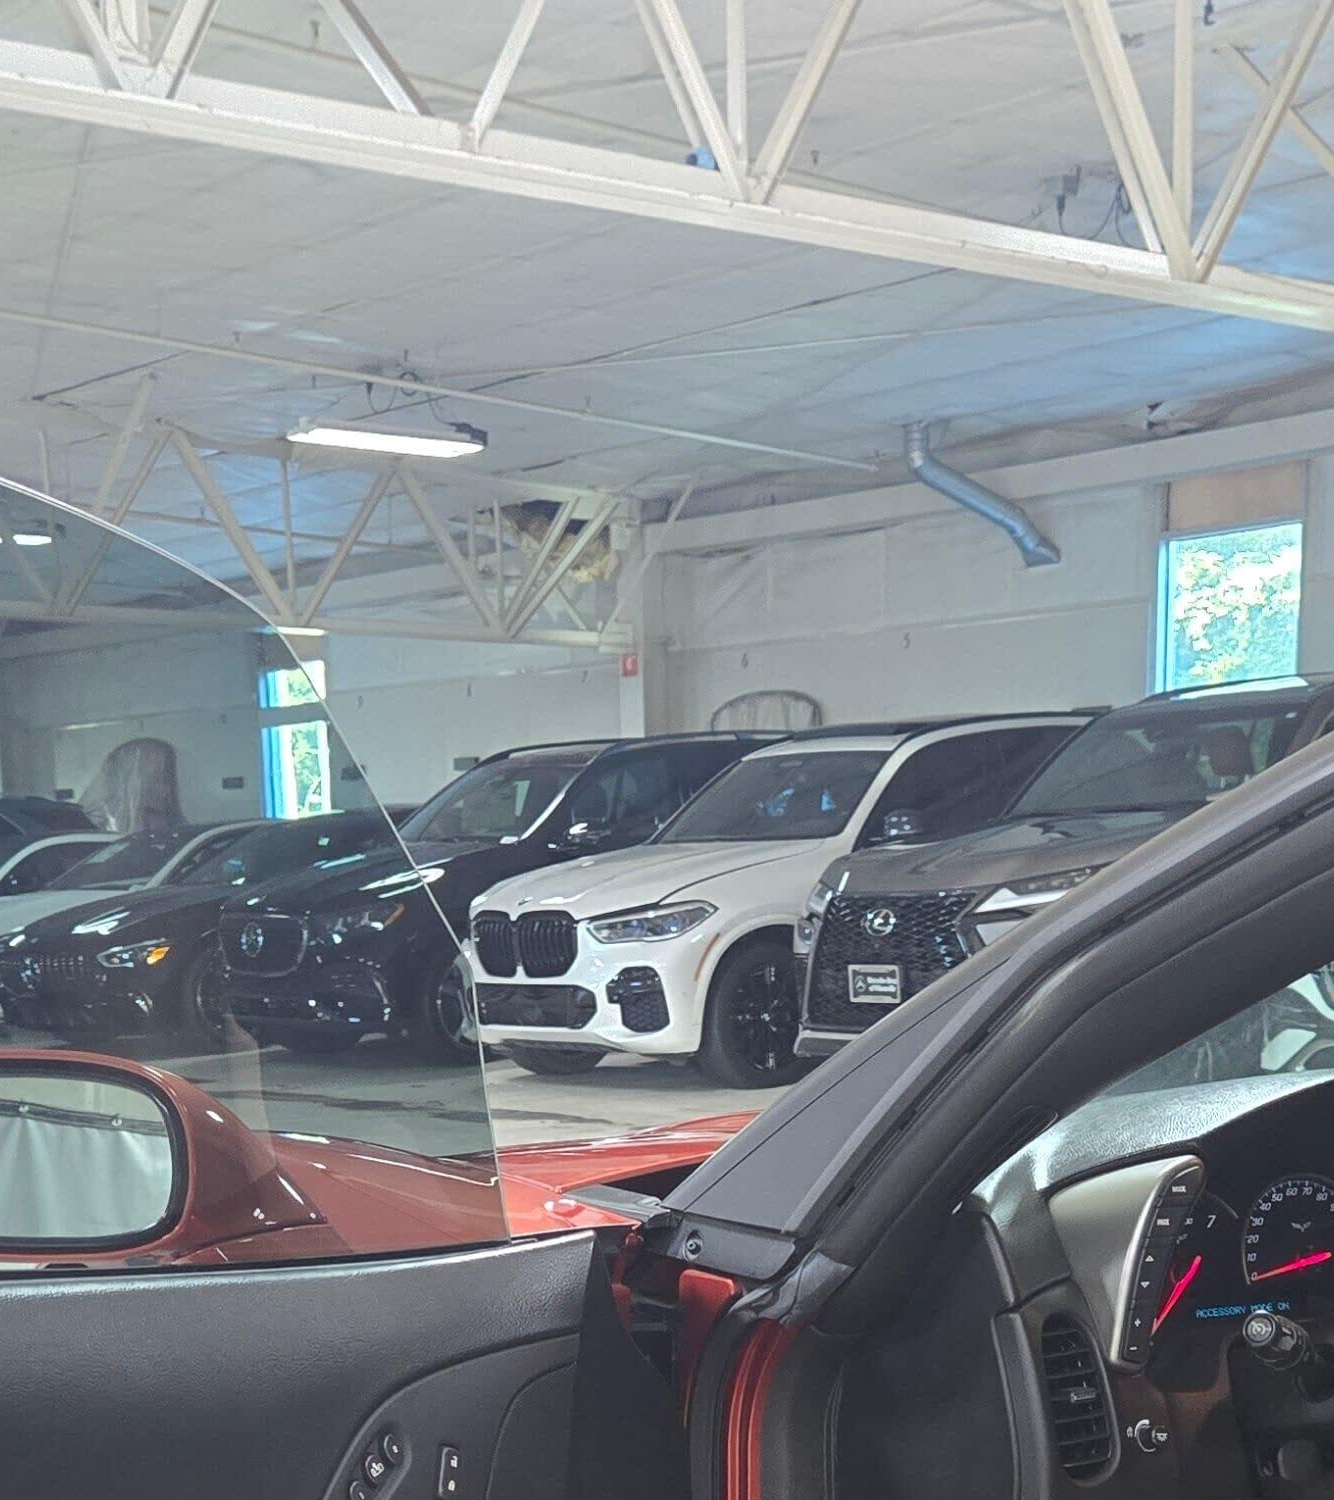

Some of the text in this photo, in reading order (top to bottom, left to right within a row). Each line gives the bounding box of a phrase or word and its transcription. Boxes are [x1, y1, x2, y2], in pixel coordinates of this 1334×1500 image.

[1285, 1187, 1298, 1197] 60
[1301, 1186, 1313, 1196] 70
[1316, 1191, 1328, 1201] 80
[1271, 1193, 1284, 1202] 50
[1260, 1202, 1272, 1211] 40
[1206, 1215, 1216, 1229] 7
[1251, 1217, 1264, 1227] 30
[1246, 1234, 1259, 1244] 20
[1246, 1253, 1257, 1262] 10
[1195, 1305, 1247, 1319] ACCESSORY
[1277, 1301, 1291, 1311] ON
